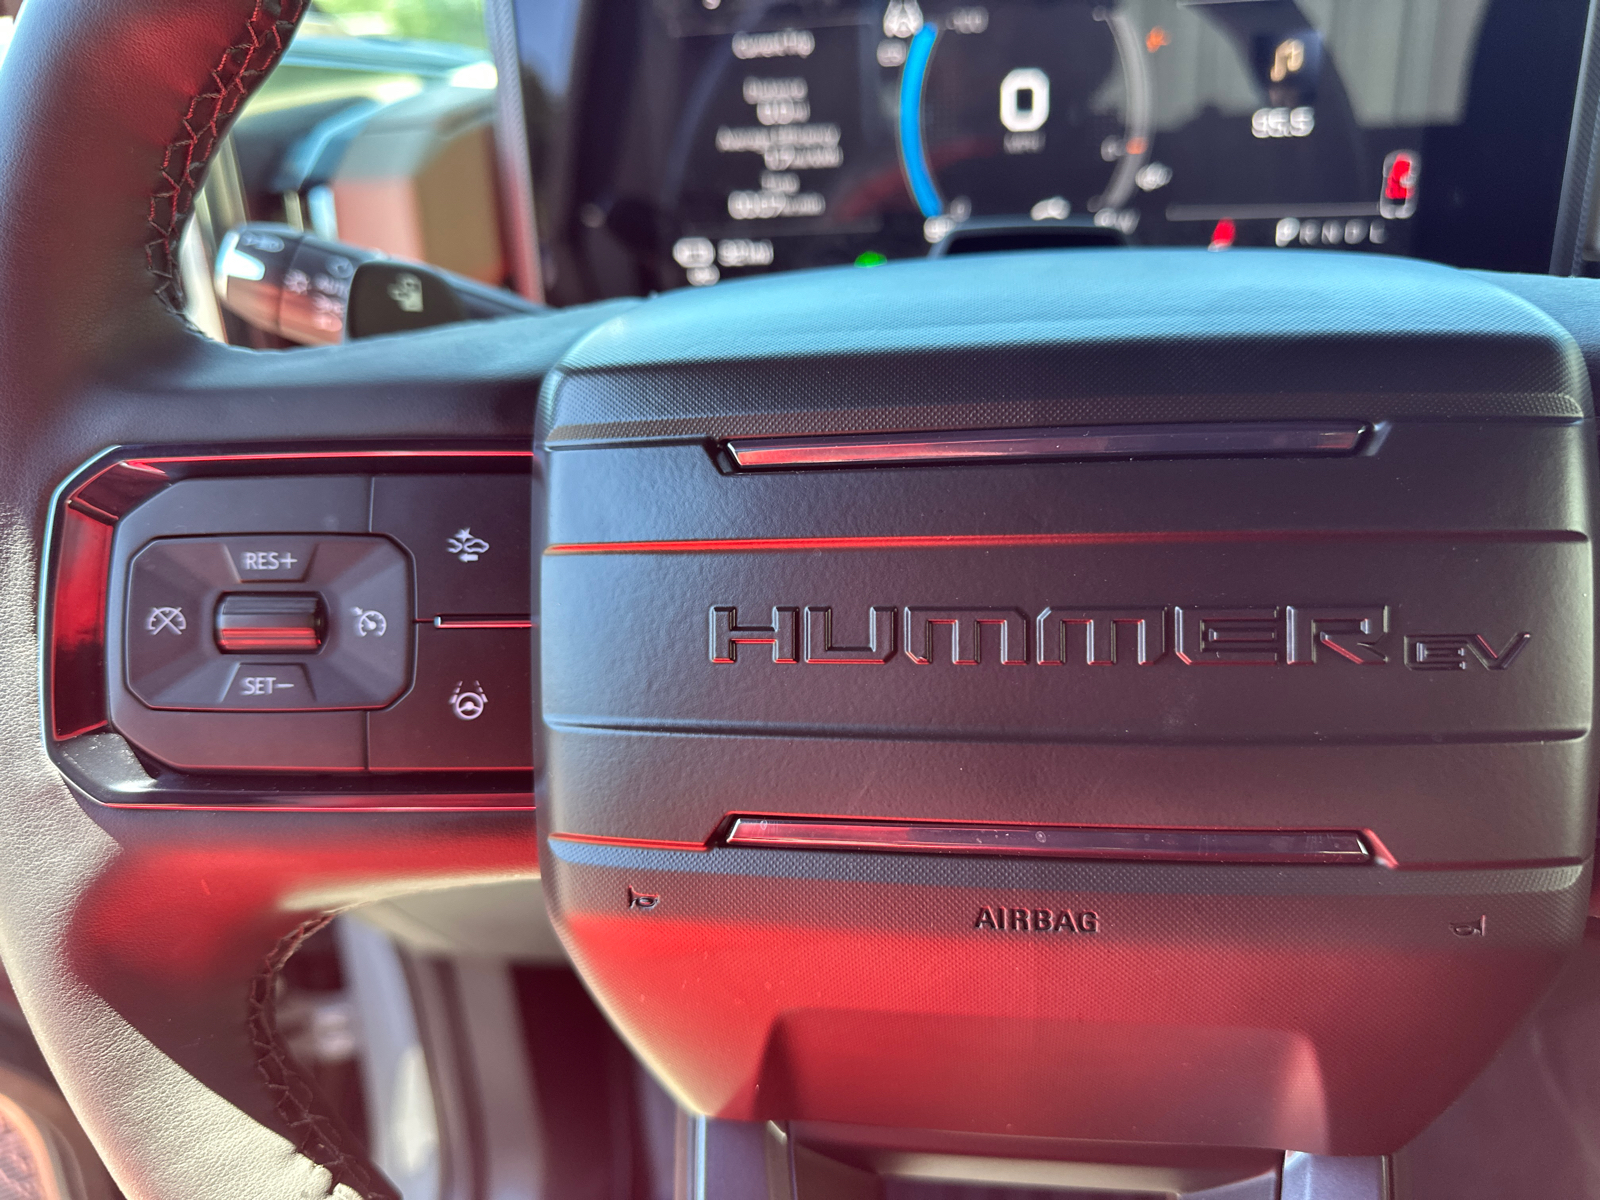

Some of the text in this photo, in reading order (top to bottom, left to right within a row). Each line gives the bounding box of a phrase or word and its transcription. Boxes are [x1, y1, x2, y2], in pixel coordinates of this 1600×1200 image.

[1000, 67, 1049, 132] 0
[243, 552, 298, 570] RES+
[708, 604, 1532, 671] HUMMER EV
[242, 677, 295, 695] SET-
[974, 905, 1100, 933] AIRBAG
